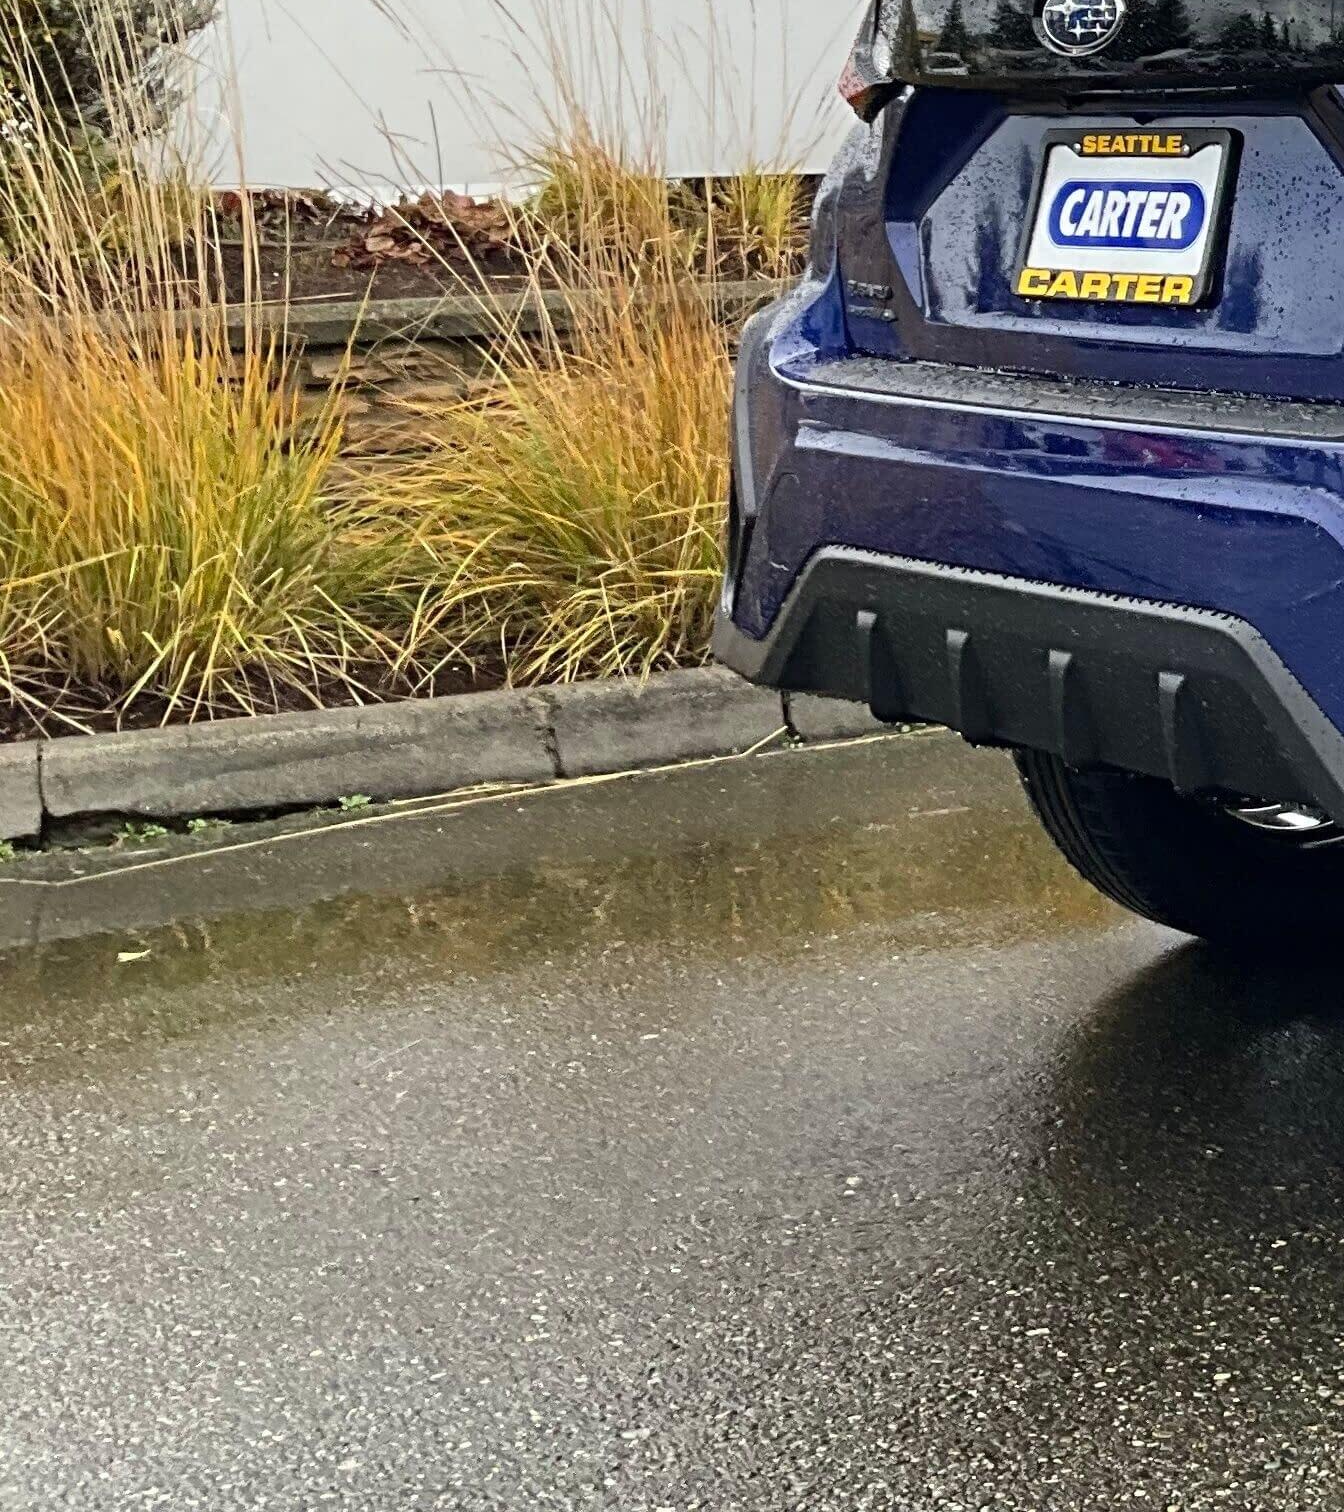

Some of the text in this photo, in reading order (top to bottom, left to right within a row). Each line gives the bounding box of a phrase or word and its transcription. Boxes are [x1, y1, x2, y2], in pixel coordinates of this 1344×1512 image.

[1082, 135, 1183, 154] SEATTLE
[1059, 188, 1192, 240] CARTER
[1017, 268, 1195, 304] CARTER
